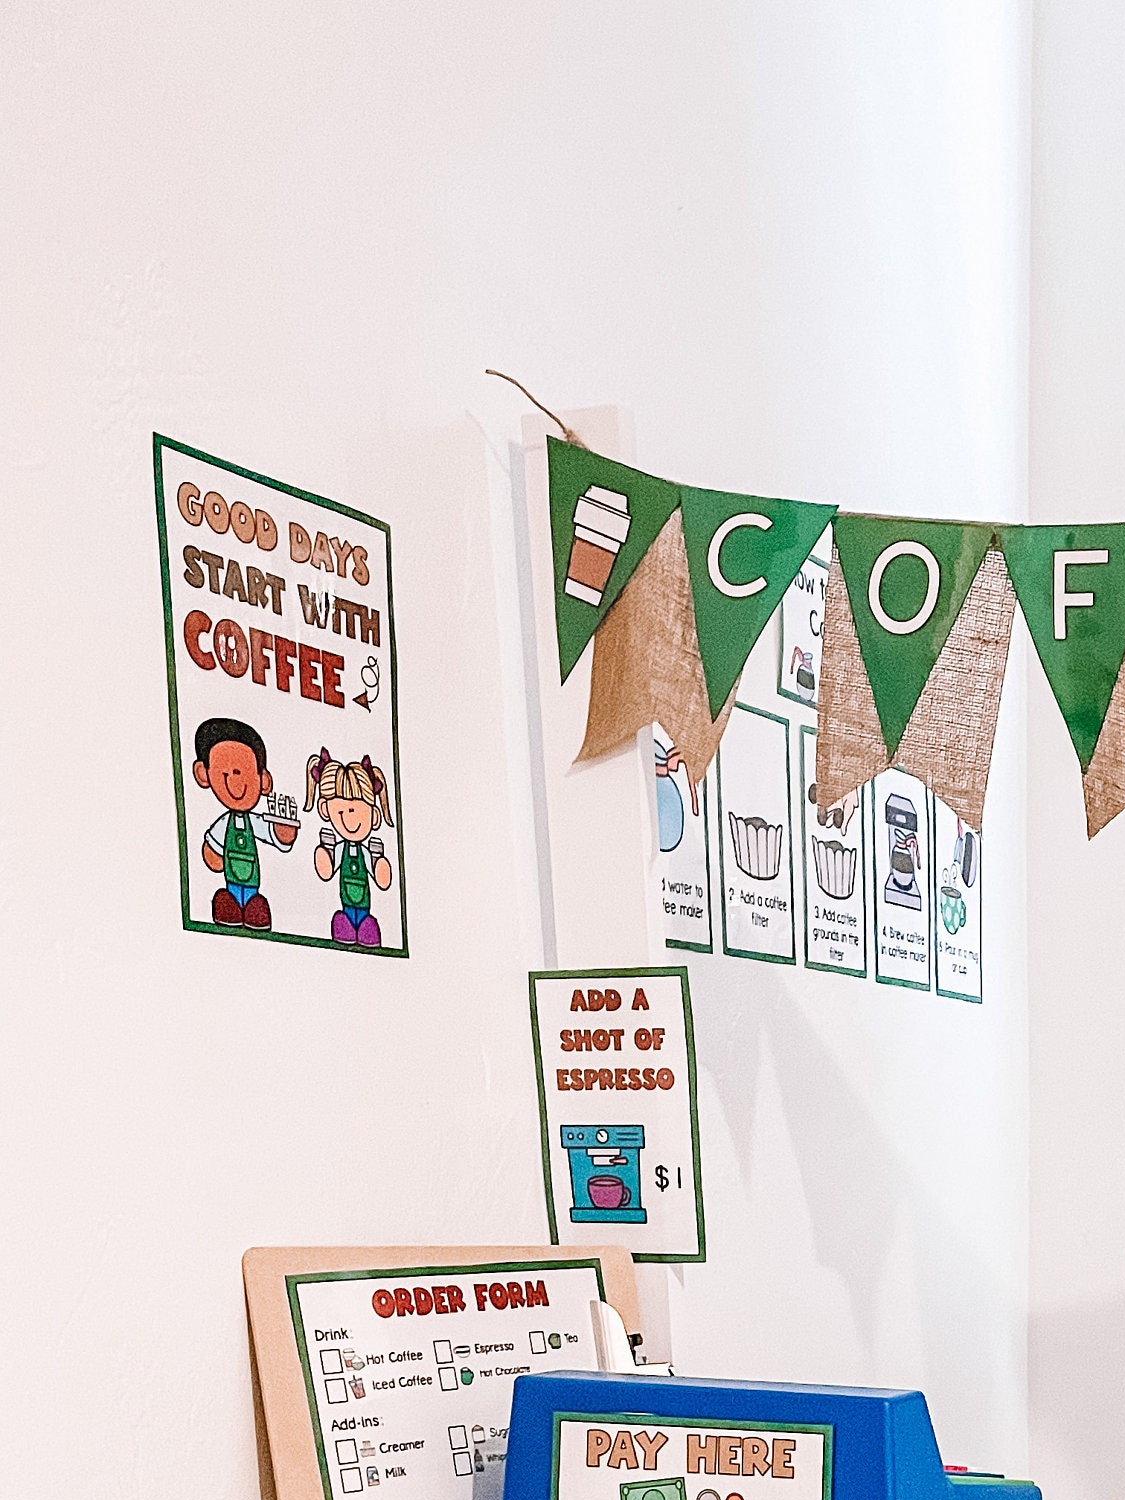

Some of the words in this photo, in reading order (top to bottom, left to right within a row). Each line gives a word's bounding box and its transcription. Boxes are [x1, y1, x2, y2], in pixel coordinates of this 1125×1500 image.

[177, 482, 278, 551] GOOD
[289, 521, 371, 586] DAYS
[183, 545, 285, 616] START
[298, 583, 381, 647] WITH
[183, 609, 345, 708] COFFEE
[570, 989, 622, 1012] ADD
[631, 988, 650, 1010] A
[560, 1028, 624, 1051] SHOT
[634, 1027, 665, 1050] OF
[556, 1067, 675, 1091] ESPRESSO
[371, 1284, 466, 1318] ORDER
[474, 1279, 550, 1312] FORM
[475, 1343, 514, 1355] Espresso
[564, 1333, 578, 1343] Tea
[366, 1355, 384, 1365] Hot
[389, 1351, 423, 1363] Coffee
[373, 1379, 395, 1390] Iced
[399, 1375, 432, 1387] Coffee
[490, 1427, 507, 1439] Sug
[379, 1440, 424, 1453] Creamer
[586, 1429, 668, 1471] PAY
[686, 1434, 796, 1479] HERE
[385, 1467, 406, 1478] Milk
